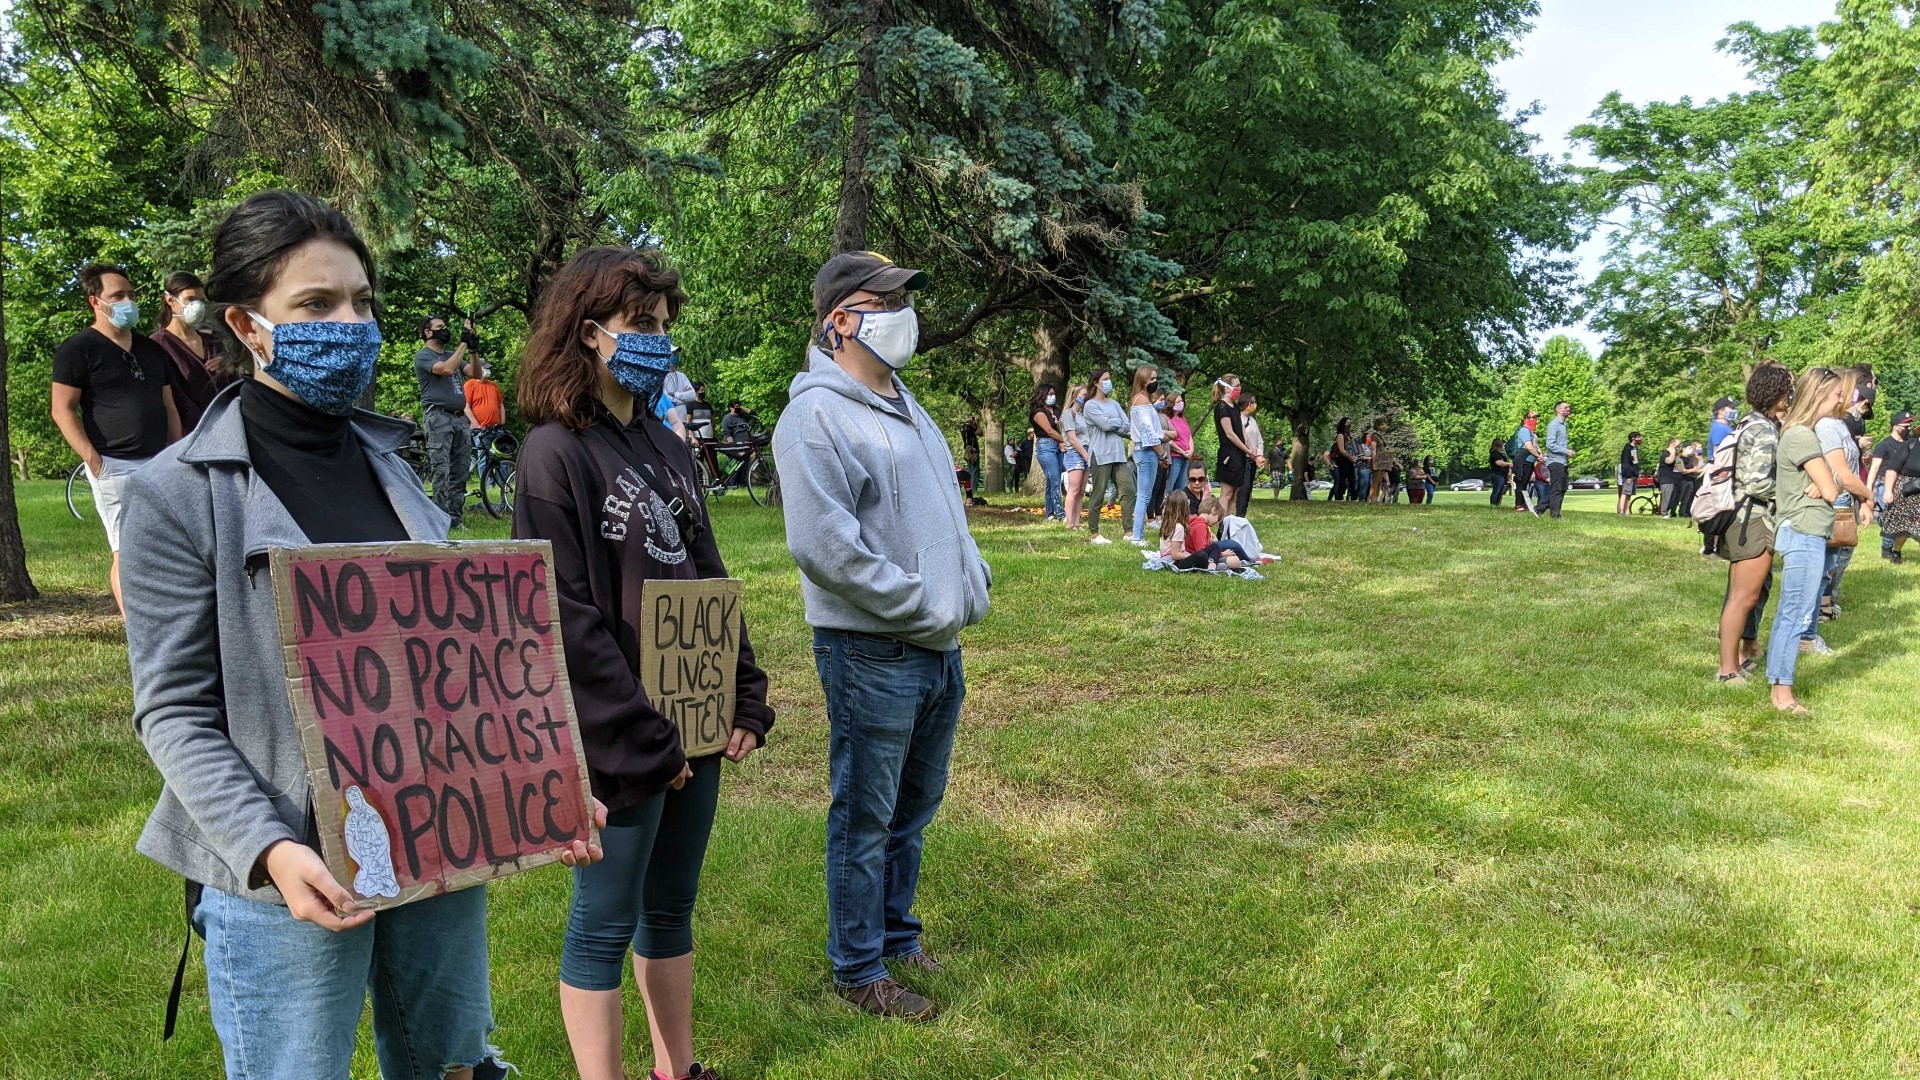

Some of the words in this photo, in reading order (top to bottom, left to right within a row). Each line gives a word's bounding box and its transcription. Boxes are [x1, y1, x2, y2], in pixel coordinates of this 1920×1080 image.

[294, 562, 378, 638] NO
[384, 558, 551, 640] JUSTICE
[655, 593, 738, 652] BLACK
[306, 645, 393, 720] NO
[404, 637, 555, 712] PEACE
[658, 651, 723, 696] LIVES
[323, 723, 404, 791] NO
[413, 706, 568, 776] RACIST
[395, 769, 580, 881] POLICE
